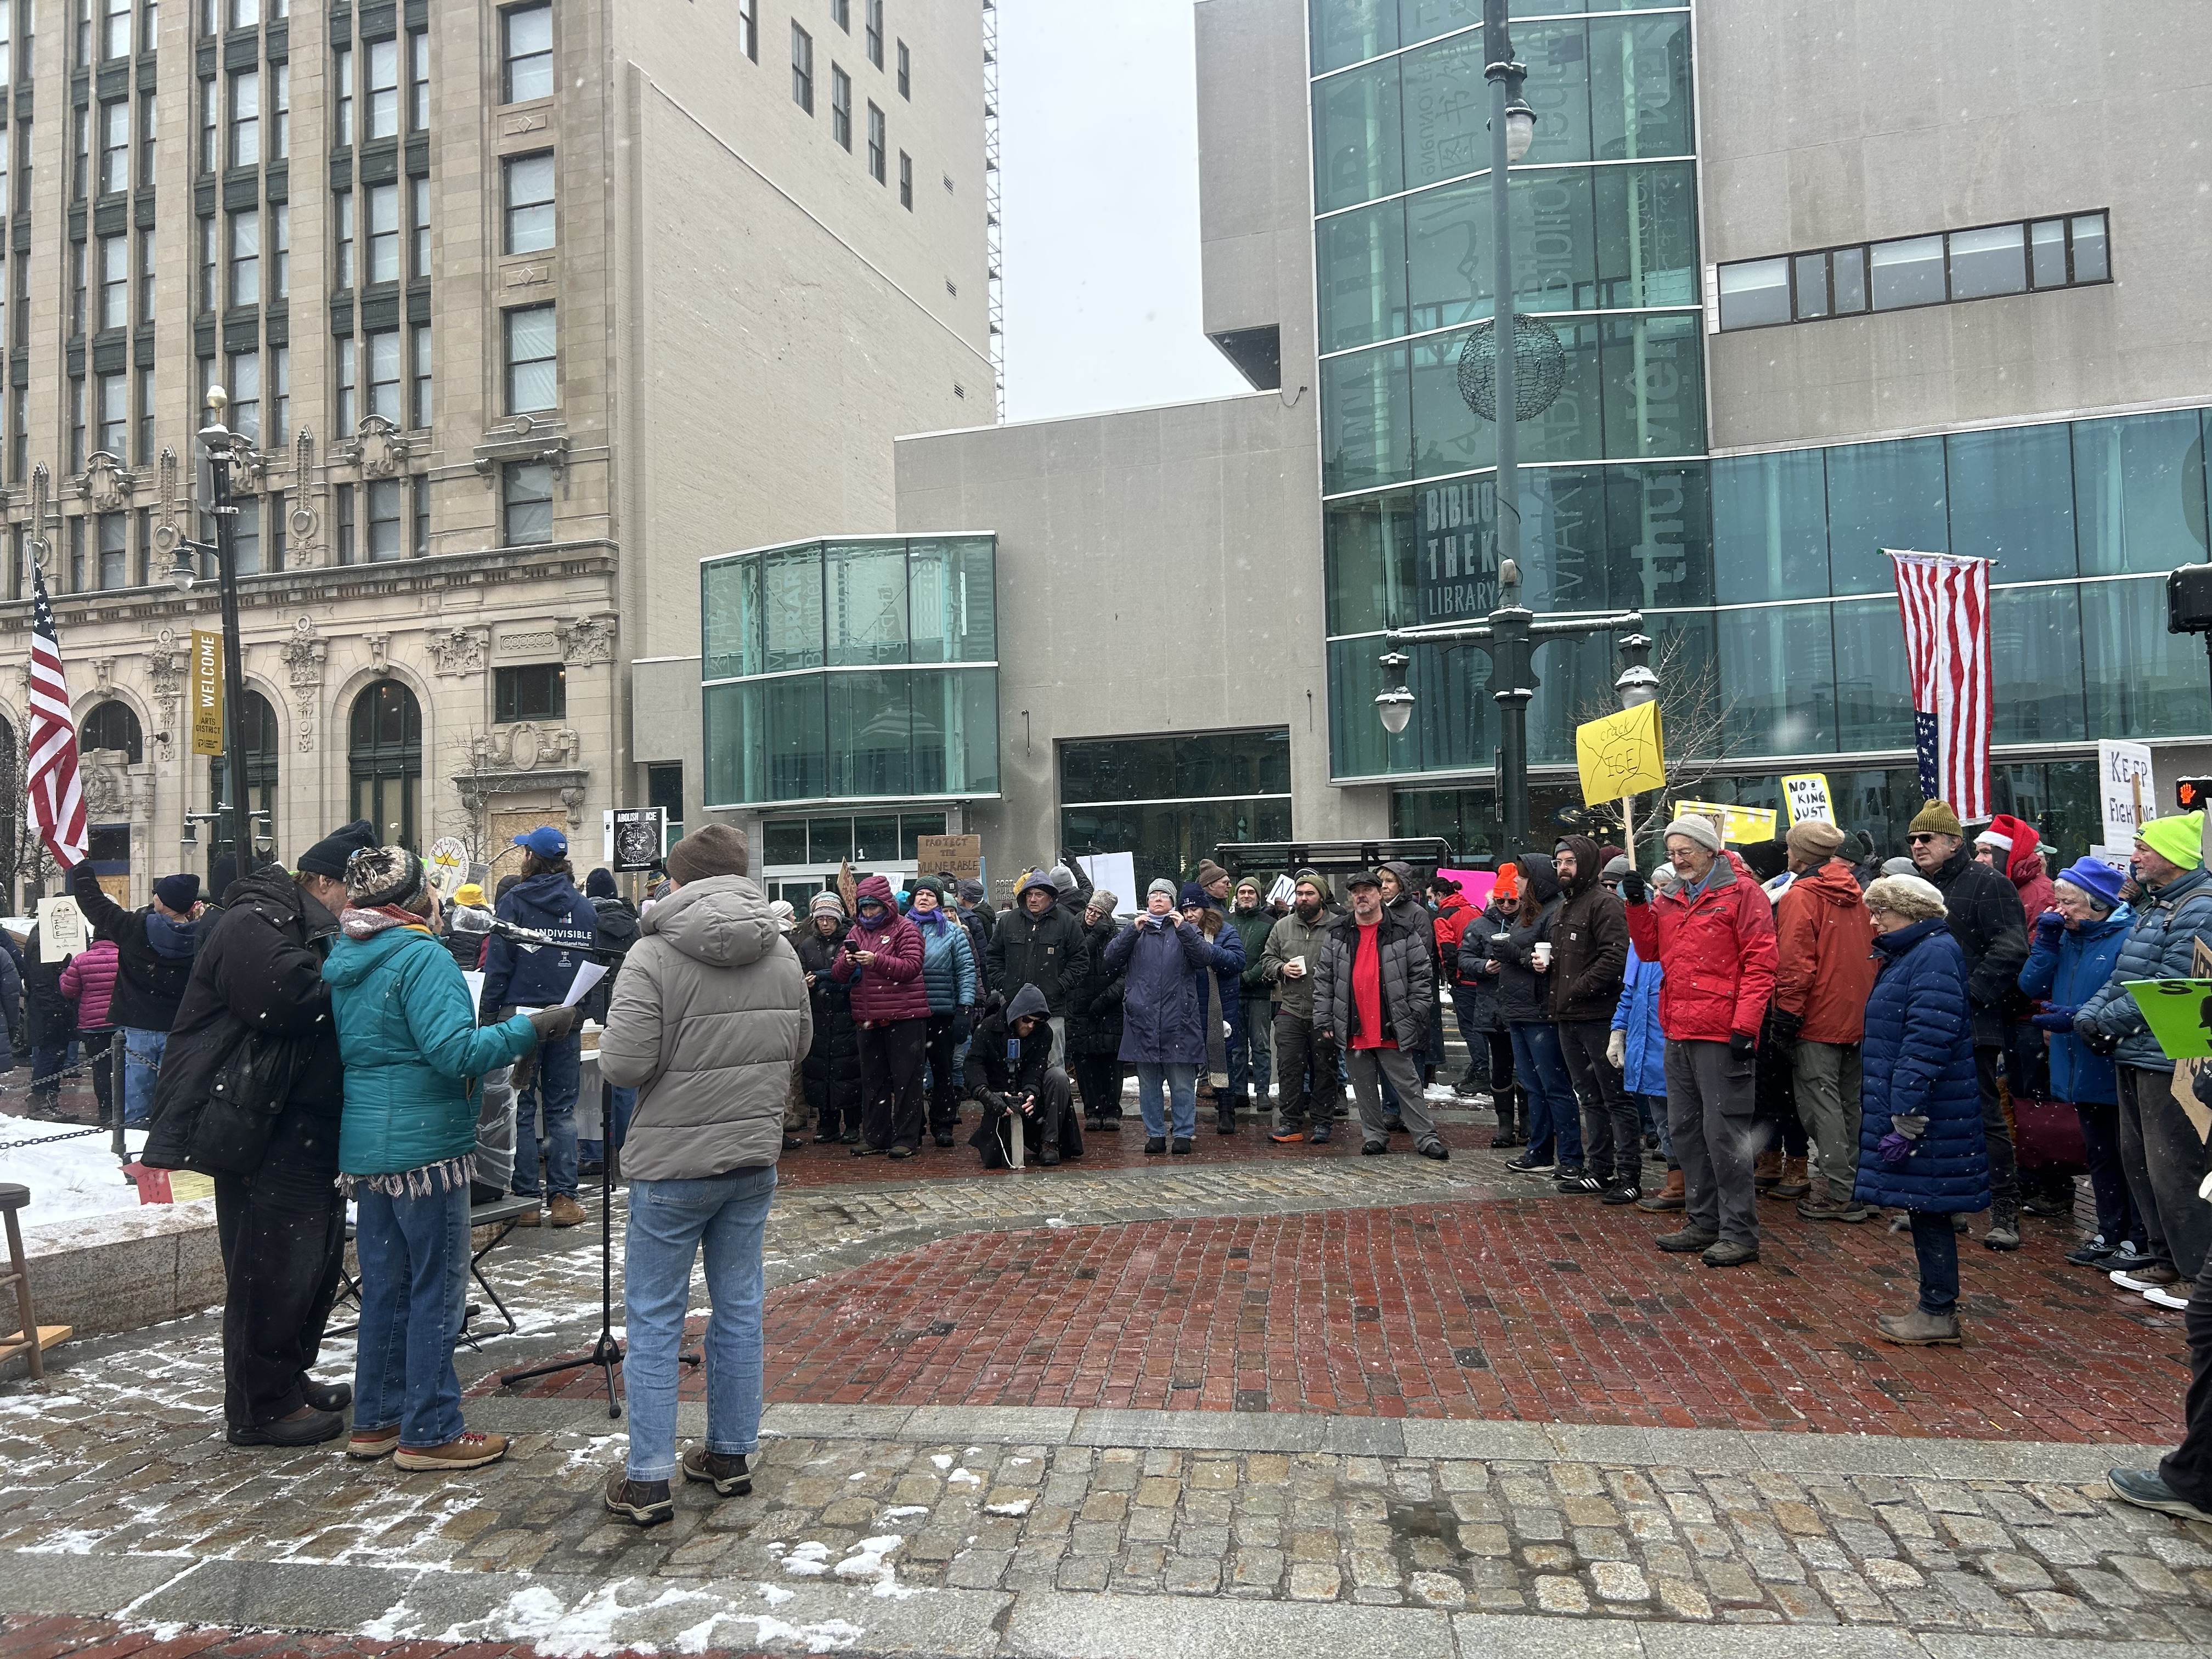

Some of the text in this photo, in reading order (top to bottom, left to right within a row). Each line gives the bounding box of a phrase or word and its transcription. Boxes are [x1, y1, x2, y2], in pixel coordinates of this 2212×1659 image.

[1426, 482, 1493, 531] BIBLIO
[1427, 531, 1496, 579] THEK
[1429, 580, 1495, 616] LIBRARY
[201, 636, 215, 707] WELCOME
[201, 717, 216, 725] ARTS
[196, 724, 221, 734] DISTRICT
[1600, 717, 1629, 741] crack
[1605, 748, 1637, 777] ICE
[1788, 781, 1806, 793] NO
[1797, 791, 1826, 804] KING
[617, 812, 639, 822] ABOLISH
[1794, 805, 1826, 821] JUST
[2109, 797, 2154, 824] FIGHING
[1699, 814, 1720, 829] T'S
[444, 837, 462, 856] Lying
[926, 838, 968, 847] PROTECT
[857, 848, 865, 859] 1
[918, 860, 980, 873] VULNERABLE
[534, 928, 592, 940] INDIVISIBLE
